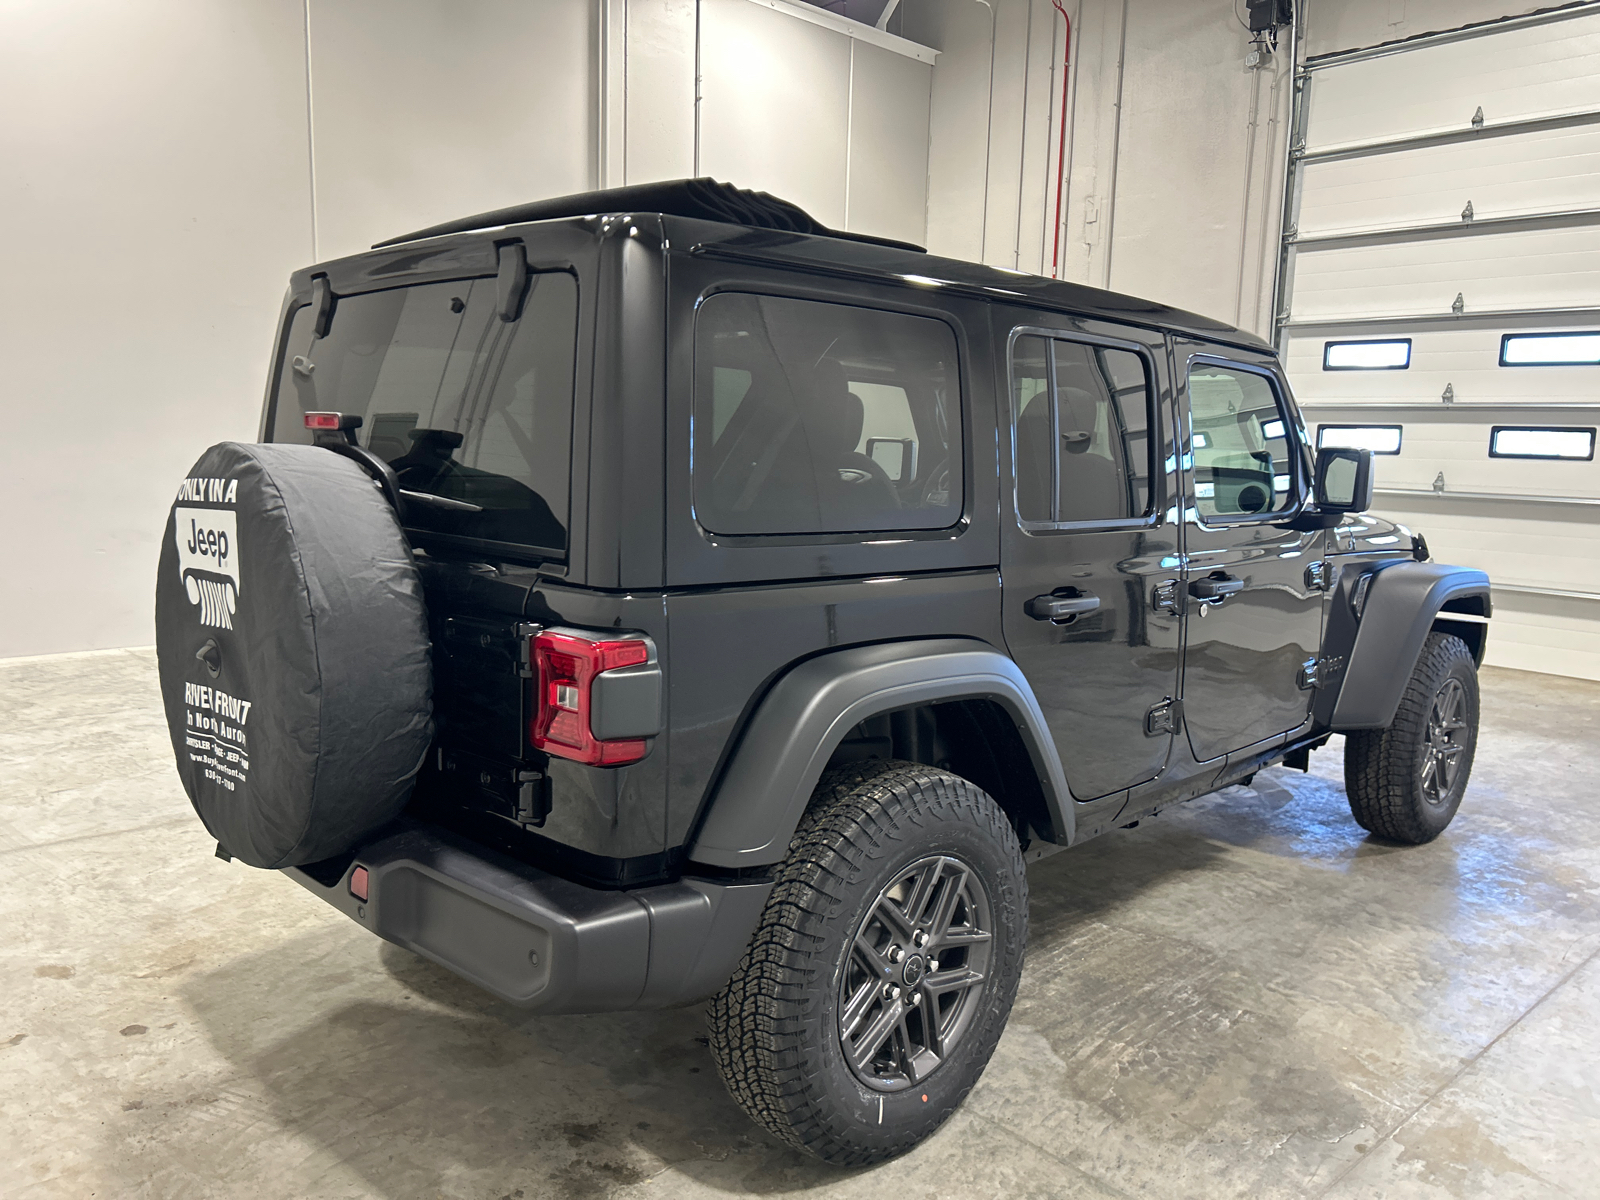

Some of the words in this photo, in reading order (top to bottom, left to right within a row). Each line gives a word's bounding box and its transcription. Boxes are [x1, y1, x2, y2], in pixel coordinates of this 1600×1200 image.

[209, 478, 225, 503] IN
[225, 479, 239, 503] A
[187, 518, 229, 568] Jeep
